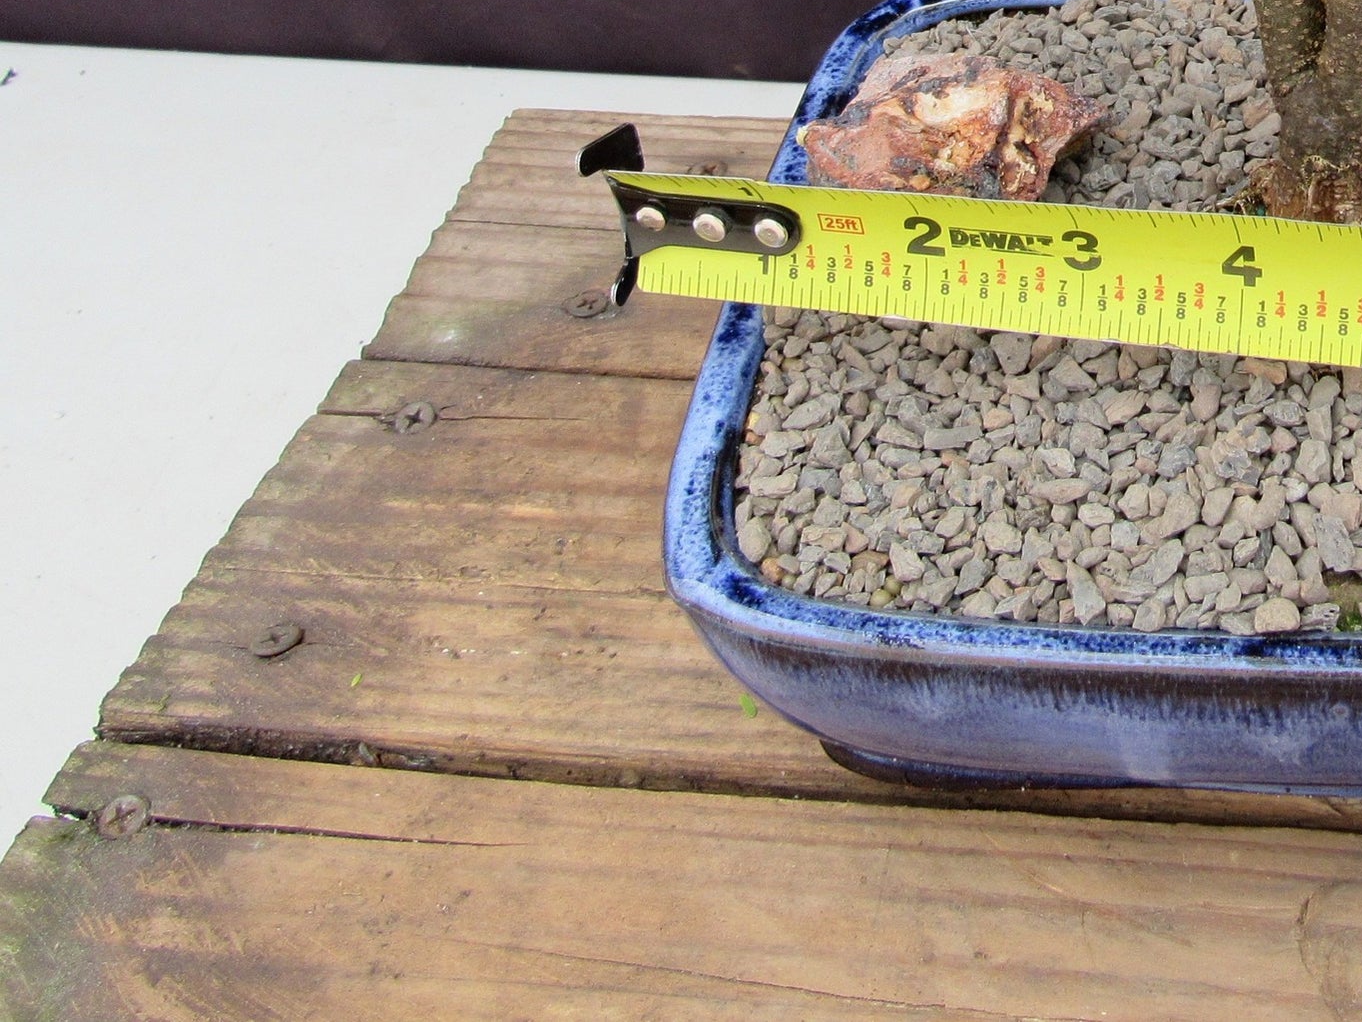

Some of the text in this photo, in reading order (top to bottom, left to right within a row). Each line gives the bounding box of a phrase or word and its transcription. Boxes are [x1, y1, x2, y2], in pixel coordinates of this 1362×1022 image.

[824, 217, 858, 231] 25ft
[903, 216, 945, 257] 2
[1061, 230, 1102, 271] 3
[1221, 245, 1263, 287] 4
